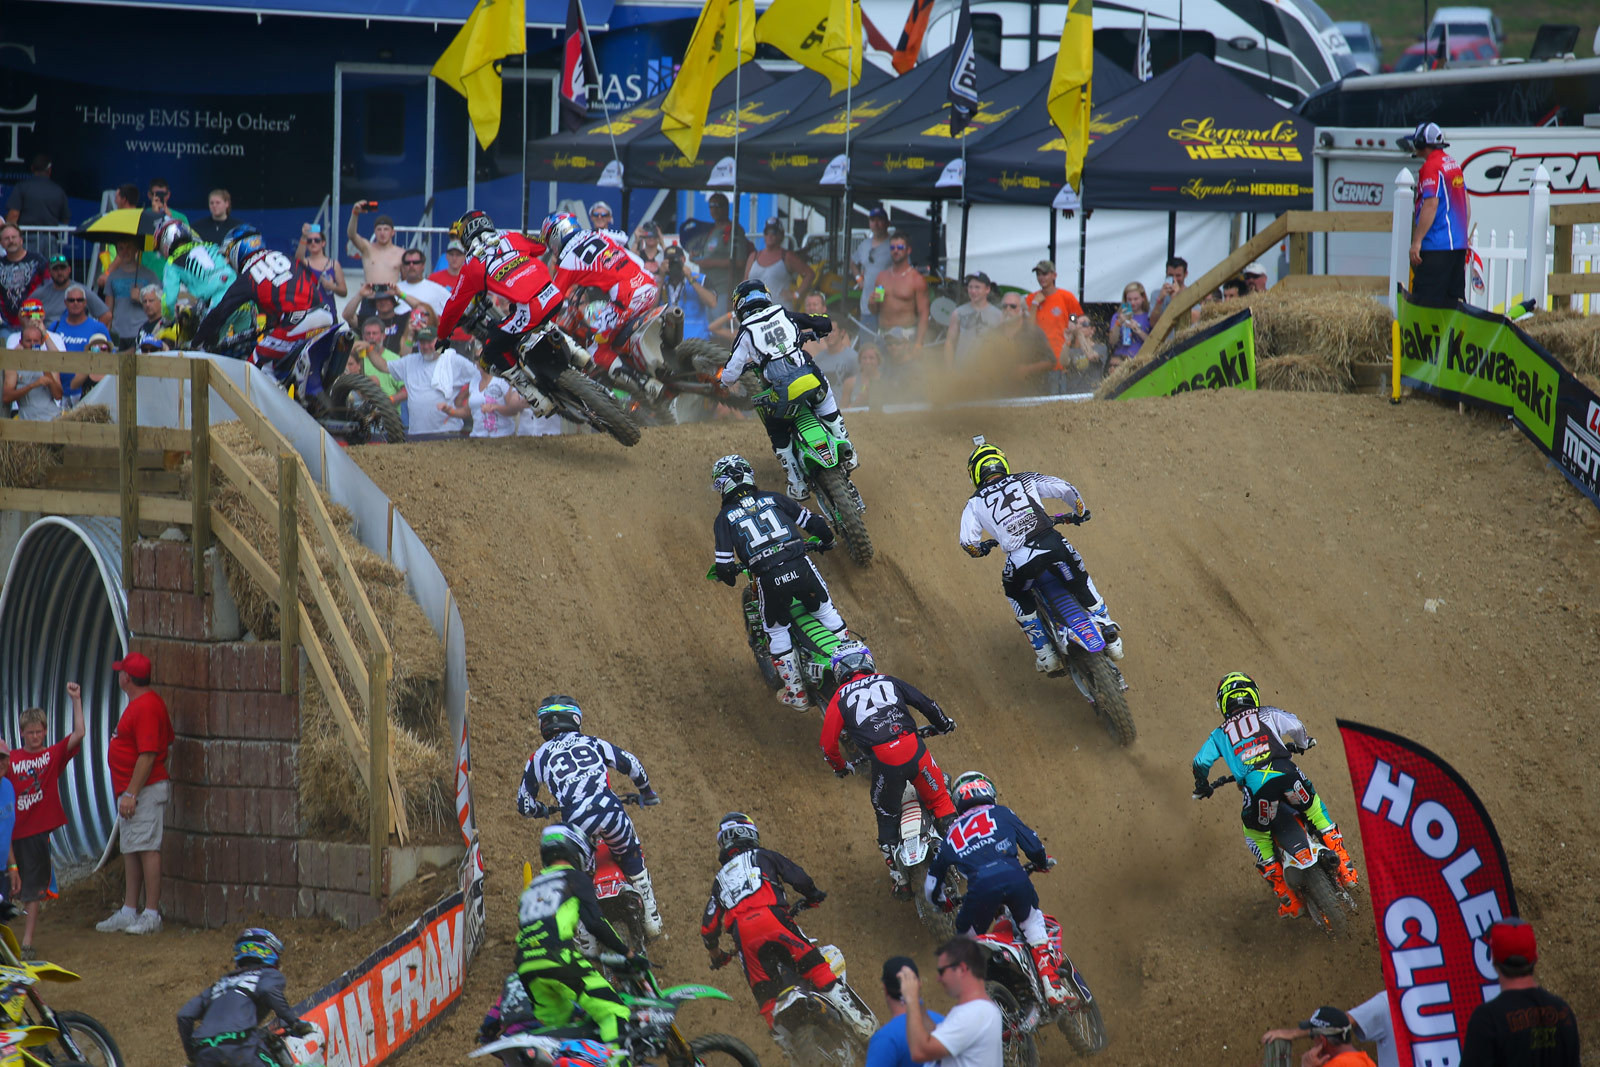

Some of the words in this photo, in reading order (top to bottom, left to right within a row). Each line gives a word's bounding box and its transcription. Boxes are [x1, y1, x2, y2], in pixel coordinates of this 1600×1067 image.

[149, 109, 191, 128] EMS
[194, 110, 233, 134] Help
[1168, 116, 1298, 145] Legends
[125, 138, 246, 159] www.upmc.com
[1184, 145, 1303, 162] HEROES
[1250, 183, 1300, 197] HEROES
[1333, 177, 1384, 206] CERNICS
[249, 250, 292, 286] 46
[763, 325, 788, 348] 48
[1400, 321, 1441, 367] aki
[1446, 327, 1553, 428] Kawasaki
[979, 474, 1018, 498] PEICK
[984, 479, 1032, 526] 23
[739, 508, 789, 549] 11
[773, 569, 800, 587] O'NEAL
[846, 679, 899, 727] 20
[1223, 712, 1262, 747] 10
[11, 751, 51, 775] WARNING
[547, 743, 604, 781] 39
[619, 749, 649, 782] HONDA
[564, 768, 604, 788] HONDA
[946, 808, 999, 855] 14
[957, 836, 998, 859] HONDA
[1361, 757, 1504, 1003] HOLES
[380, 910, 465, 1046] FRAM
